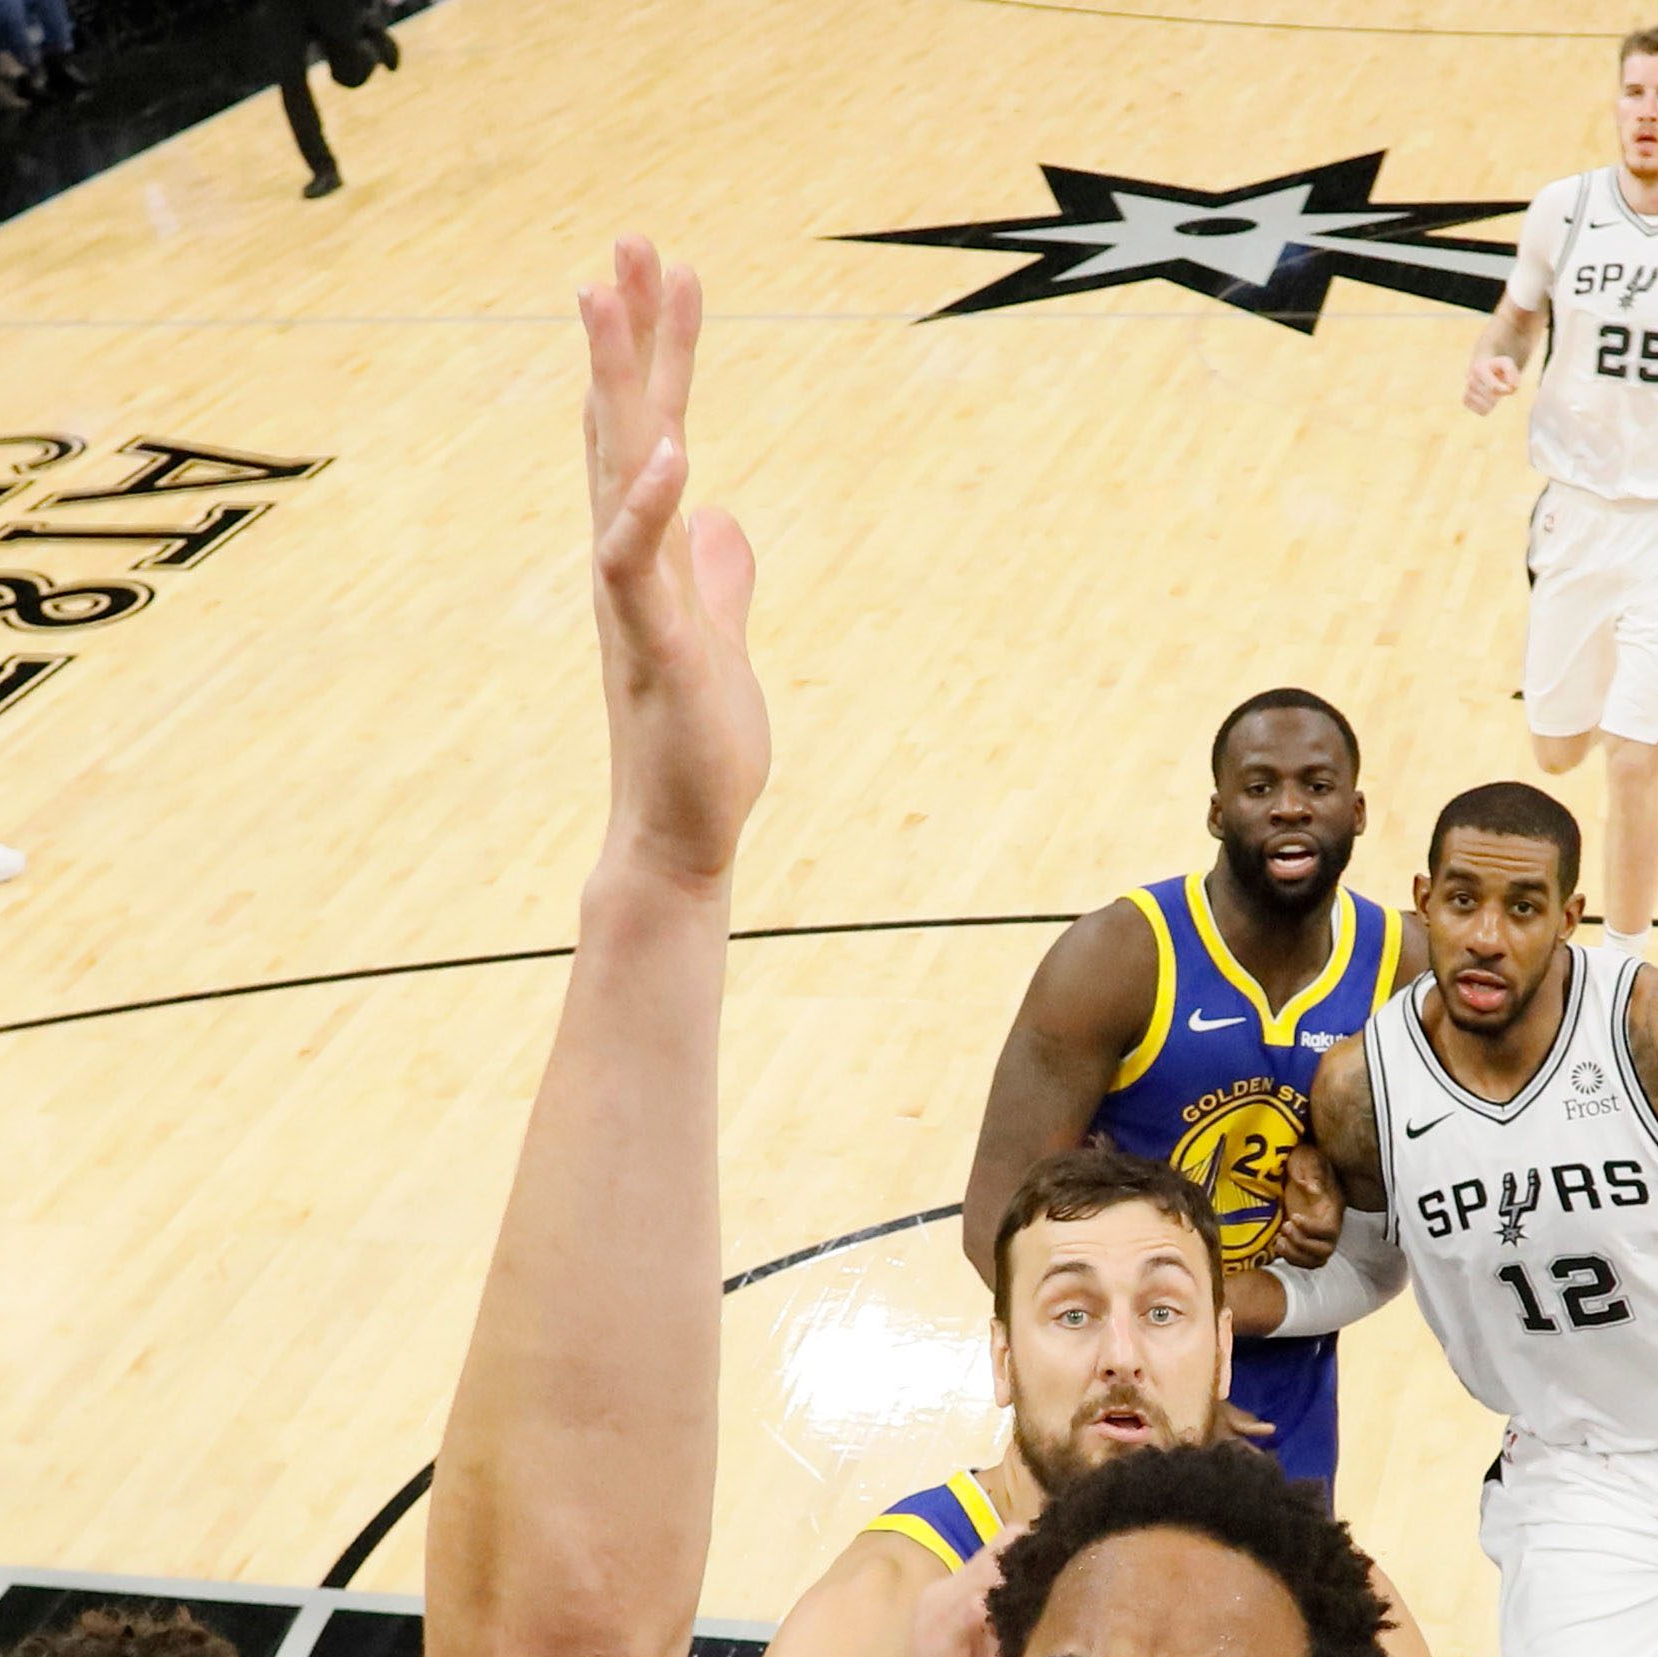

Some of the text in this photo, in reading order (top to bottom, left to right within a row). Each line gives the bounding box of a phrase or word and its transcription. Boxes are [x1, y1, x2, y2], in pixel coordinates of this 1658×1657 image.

[1182, 1076, 1276, 1123] GOLDEN
[1561, 1093, 1622, 1121] Frost
[1417, 1159, 1651, 1248] SPURS
[1494, 1254, 1637, 1336] 12
